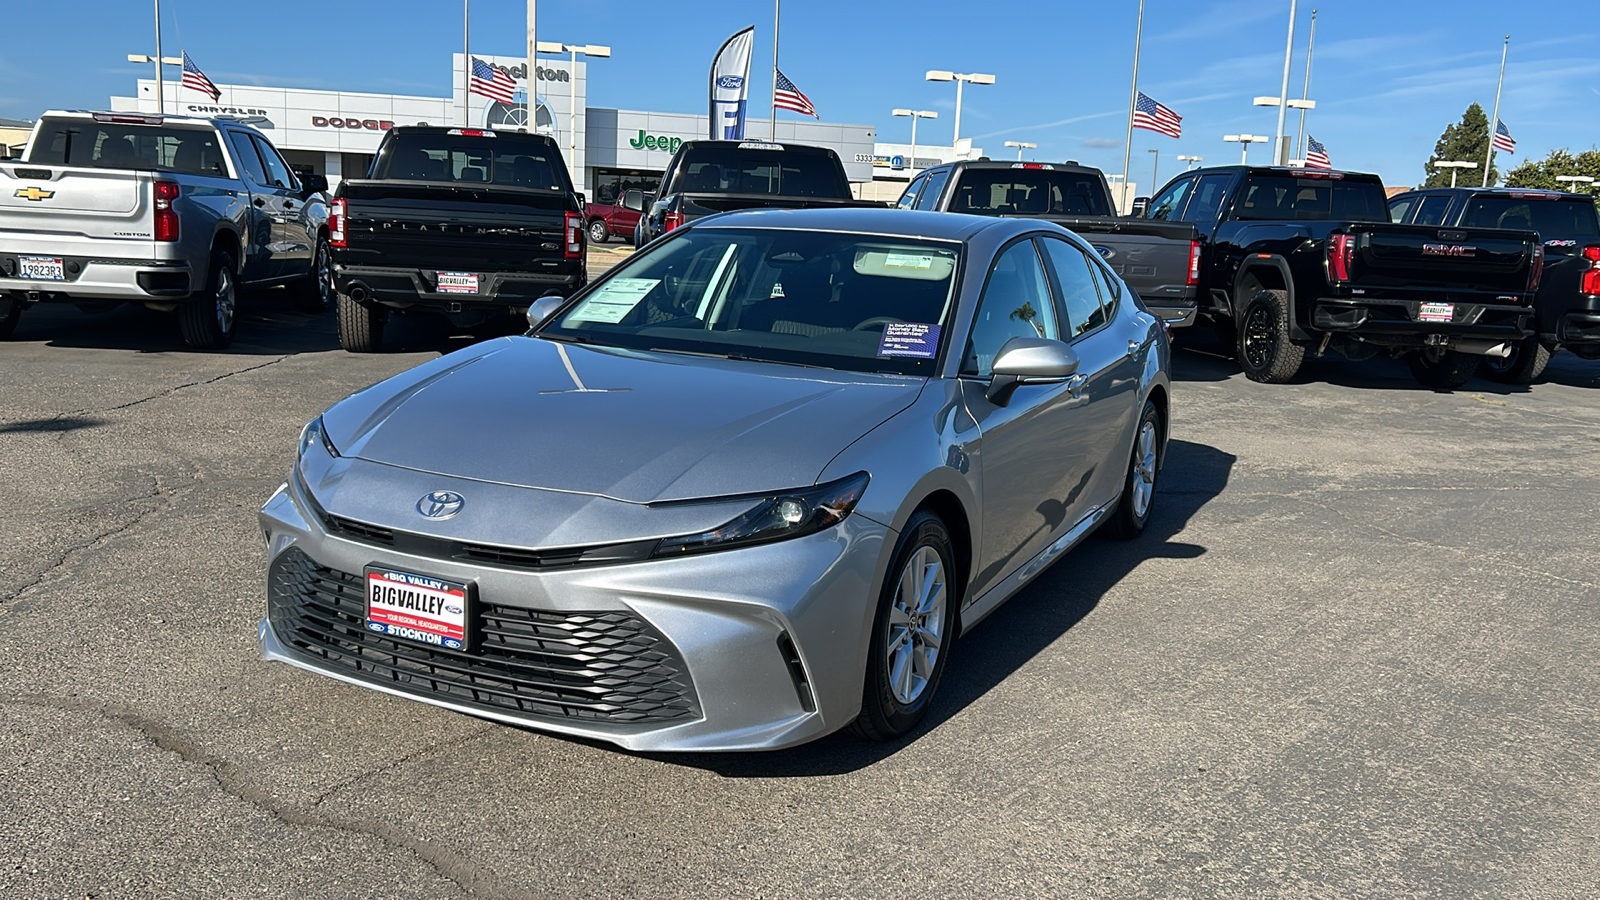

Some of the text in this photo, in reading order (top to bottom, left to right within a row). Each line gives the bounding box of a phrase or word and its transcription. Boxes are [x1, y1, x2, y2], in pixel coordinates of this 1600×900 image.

[721, 77, 743, 88] Ford
[187, 104, 267, 116] CHRYSLER
[312, 116, 396, 131] DODGE
[629, 129, 683, 155] Jeep
[856, 154, 873, 163] 3333
[383, 222, 531, 237] PLATINUM
[1422, 243, 1477, 257] GMC
[22, 264, 62, 277] 19823R3
[389, 573, 442, 590] BIG VALLEY
[373, 584, 445, 616] BIGVALLEY
[399, 615, 417, 626] REGIONAL
[418, 620, 449, 633] HEADQUARTERS
[387, 625, 441, 644] STOCKTON
